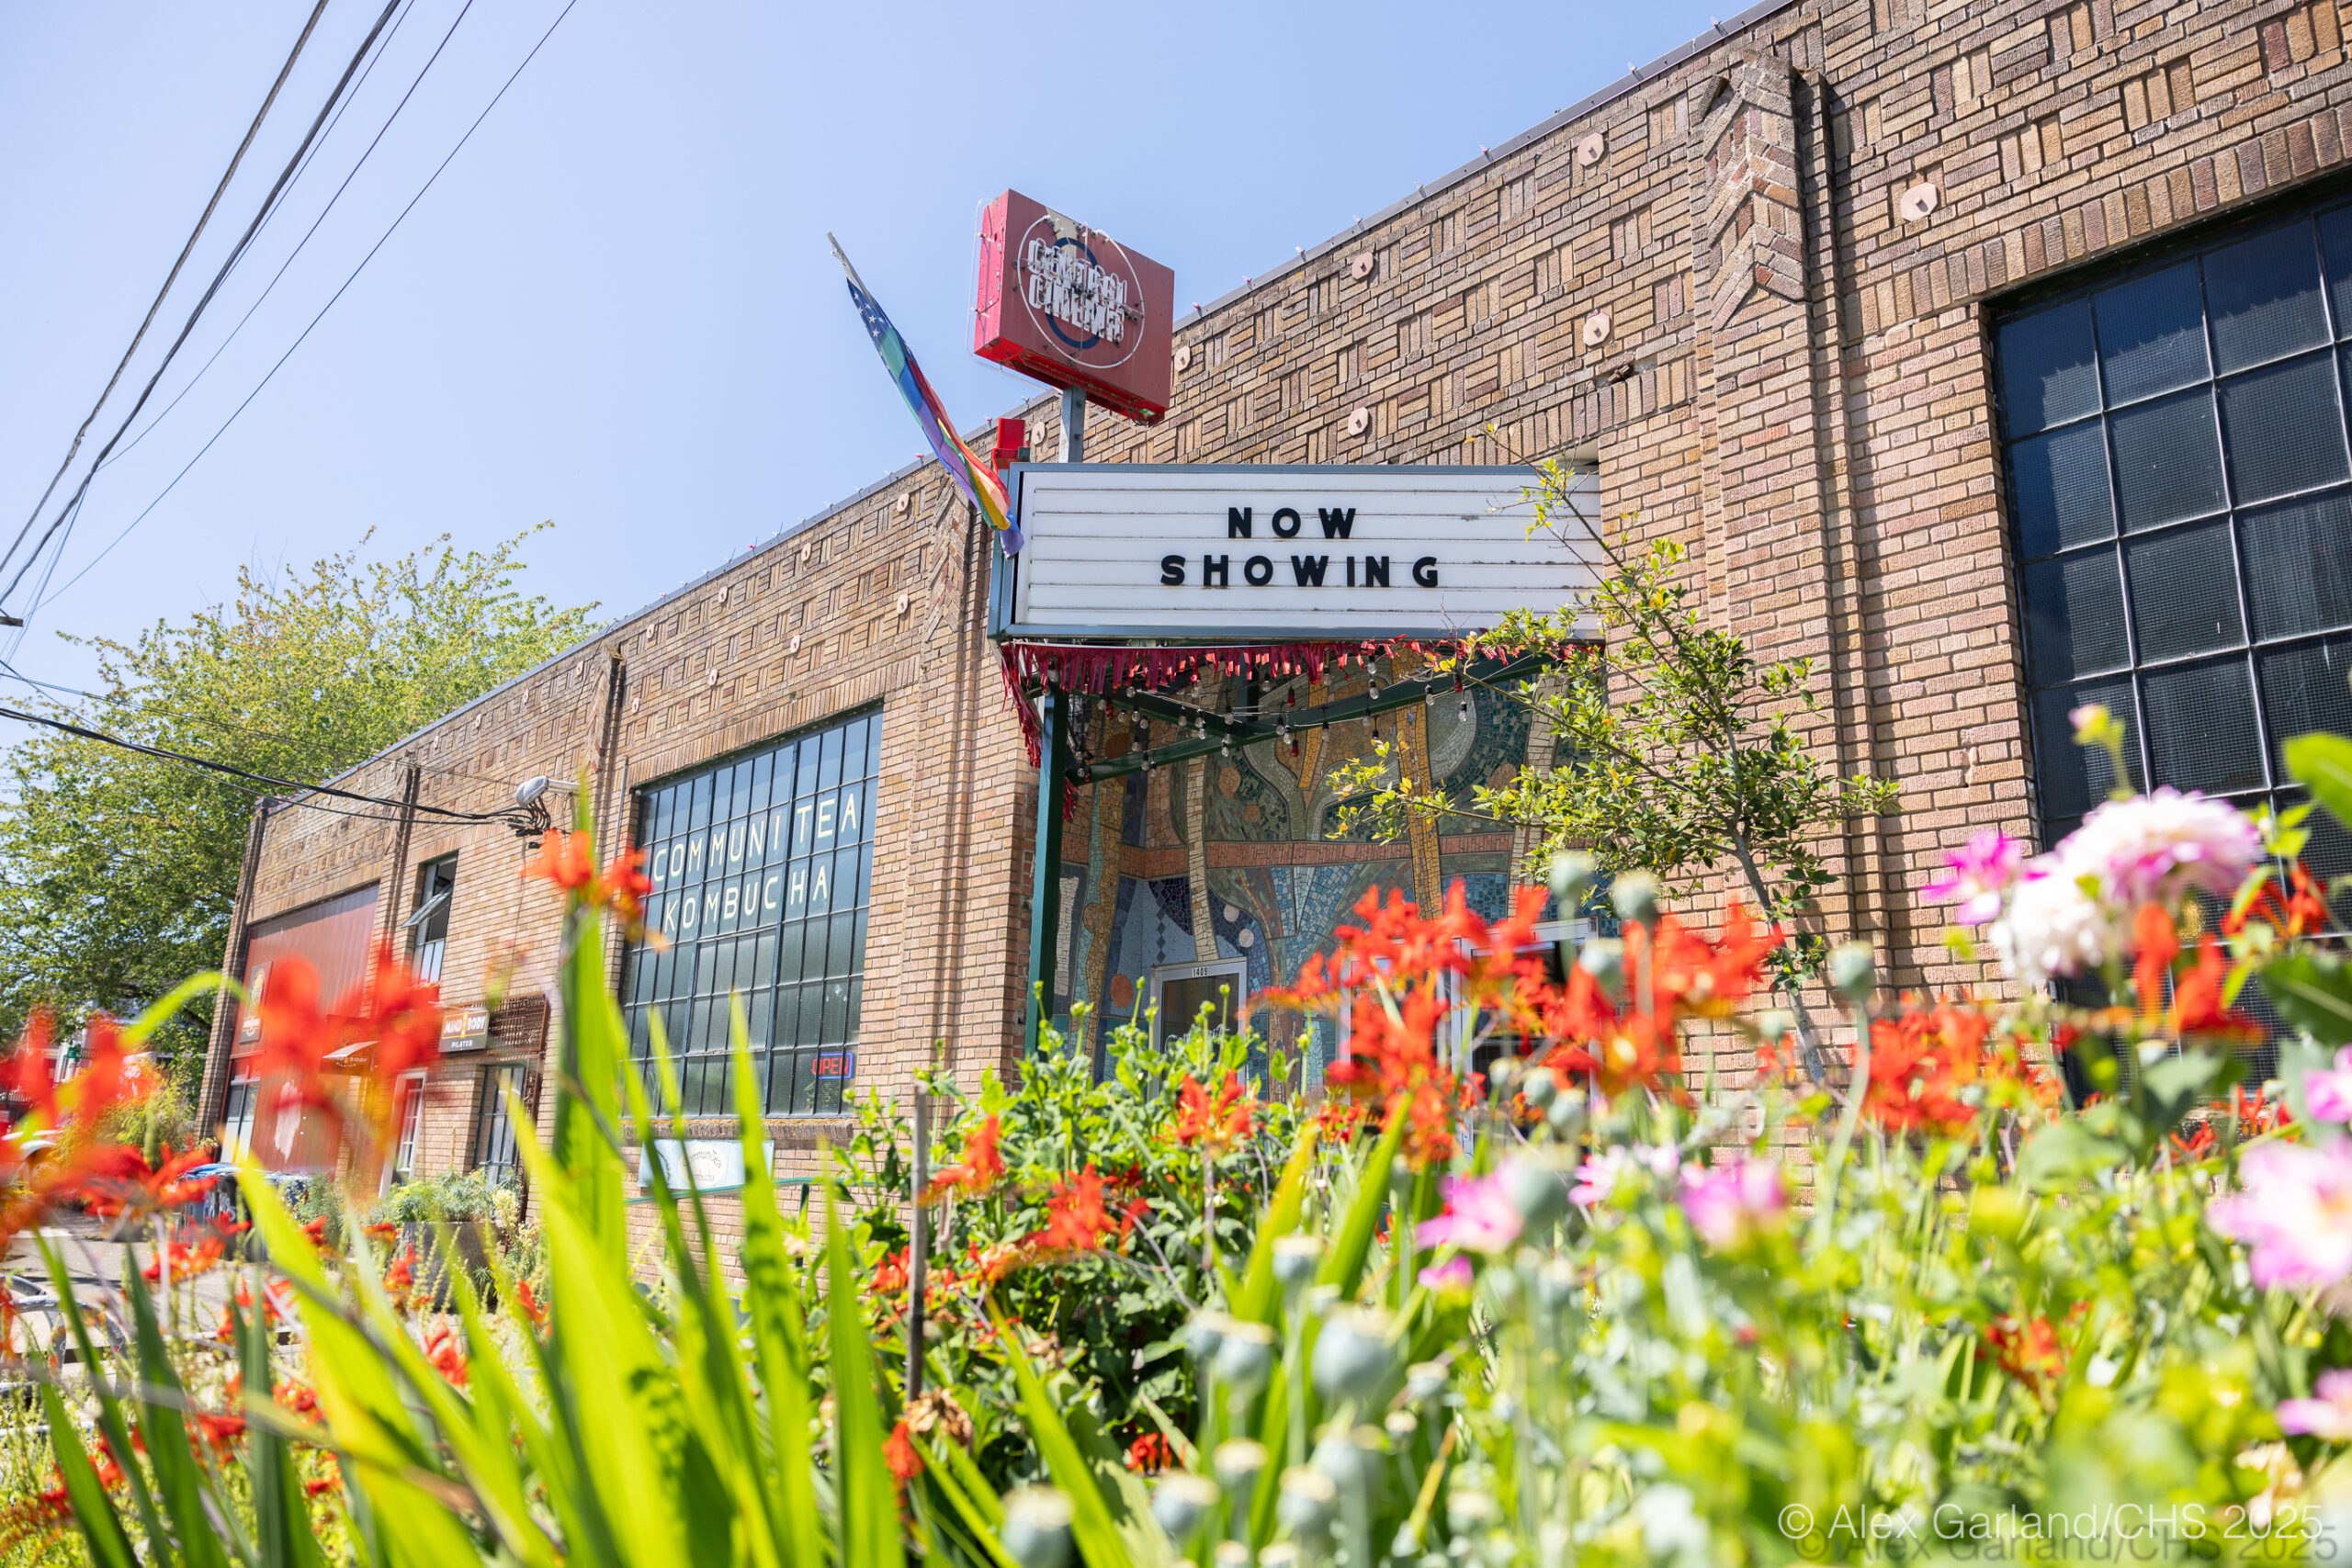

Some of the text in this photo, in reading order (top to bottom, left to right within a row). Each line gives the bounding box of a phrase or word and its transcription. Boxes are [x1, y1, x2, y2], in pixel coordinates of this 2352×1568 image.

[1027, 237, 1127, 309] CENTRAL
[1028, 273, 1124, 343] CINEMA
[1227, 507, 1356, 538] NOW
[1159, 554, 1439, 588] SHOWING
[663, 865, 829, 933] KOMBUCHA
[1193, 966, 1208, 976] 1409
[467, 1015, 486, 1031] BODY
[811, 1057, 849, 1075] OPEN
